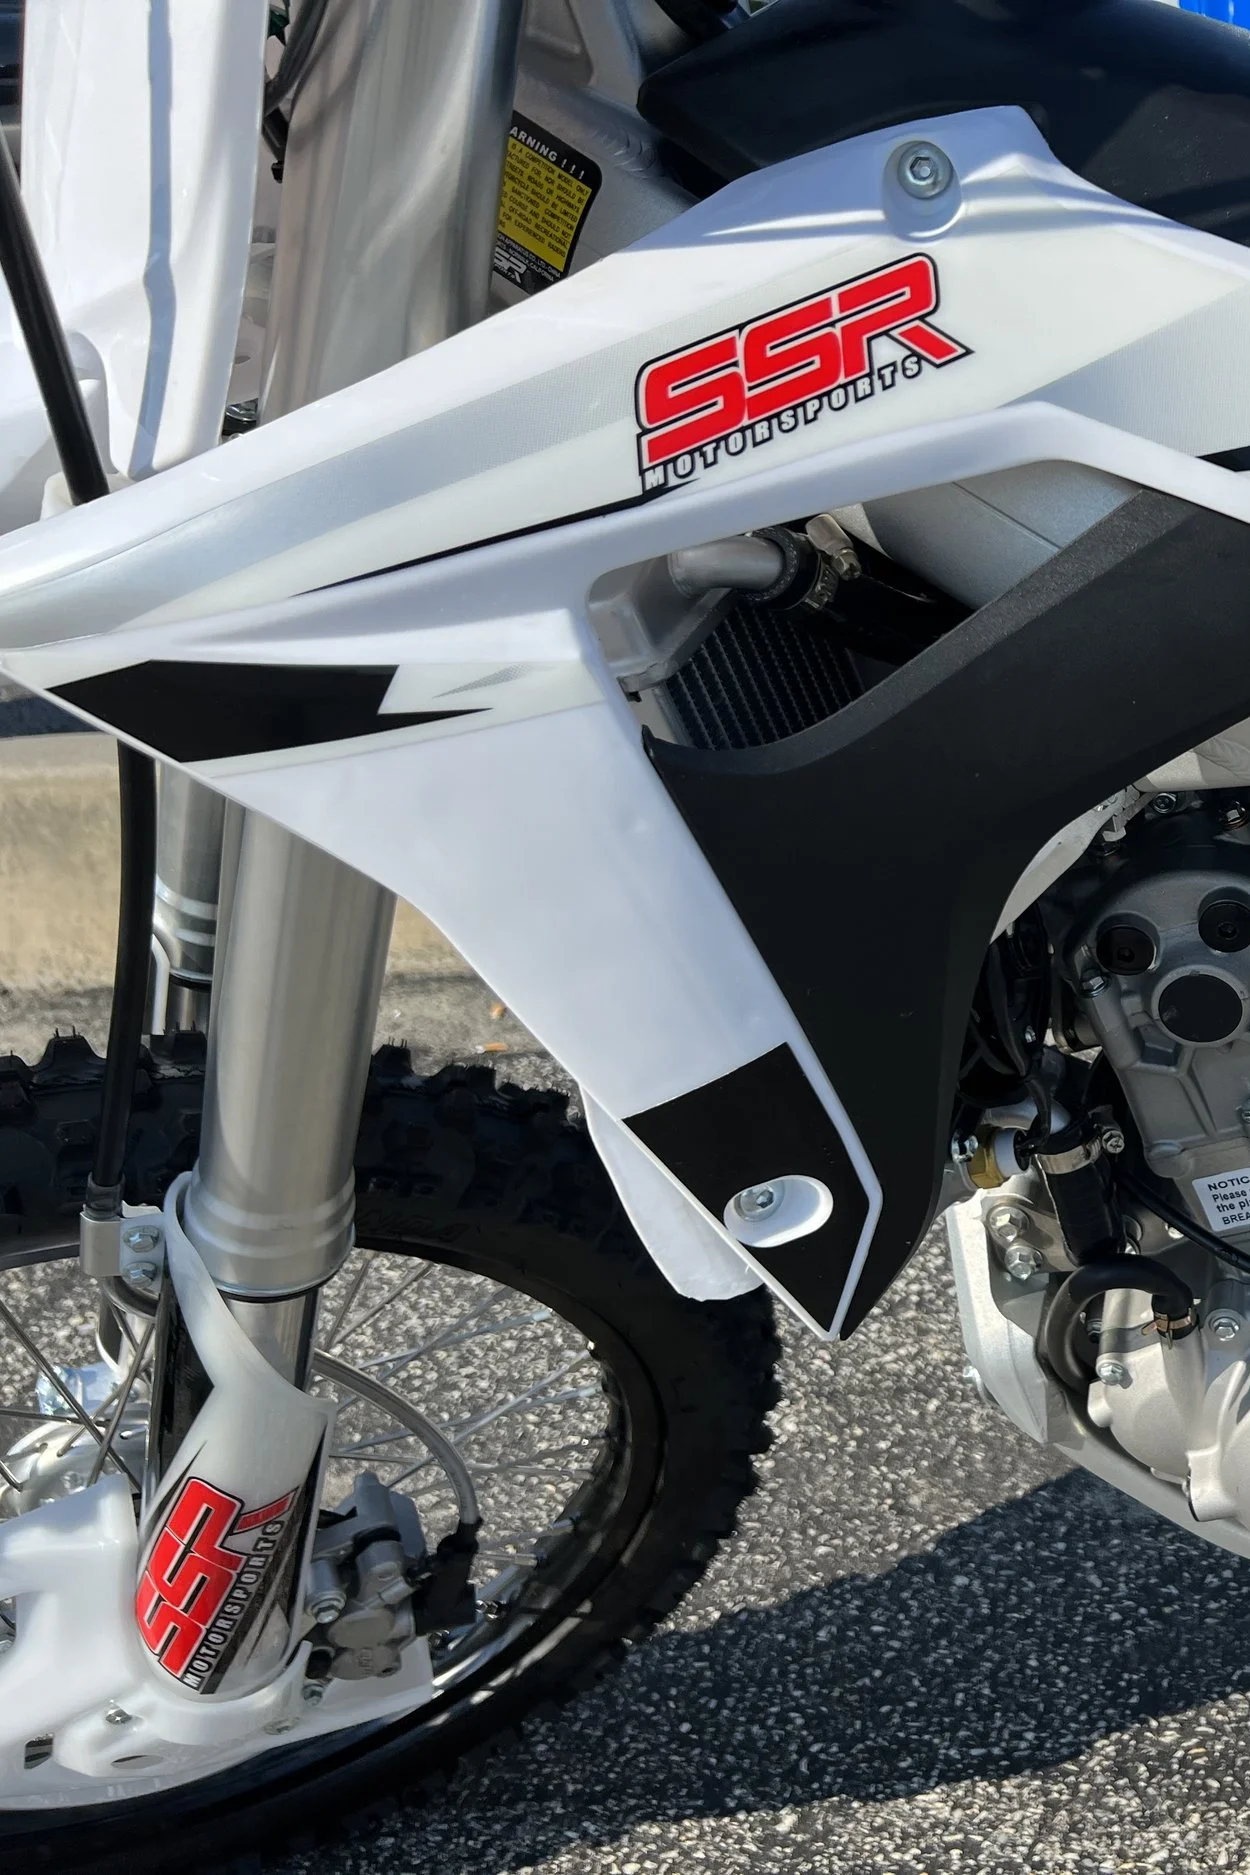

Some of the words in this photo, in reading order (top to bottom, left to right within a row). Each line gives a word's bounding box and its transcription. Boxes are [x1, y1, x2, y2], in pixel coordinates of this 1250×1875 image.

[635, 253, 974, 470] SSR
[641, 354, 923, 492] MOTORSPORTS
[1211, 1188, 1248, 1203] Please
[1216, 1201, 1236, 1213] the
[135, 1476, 301, 1681] SSR
[182, 1519, 287, 1691] MOTORSPORTS
